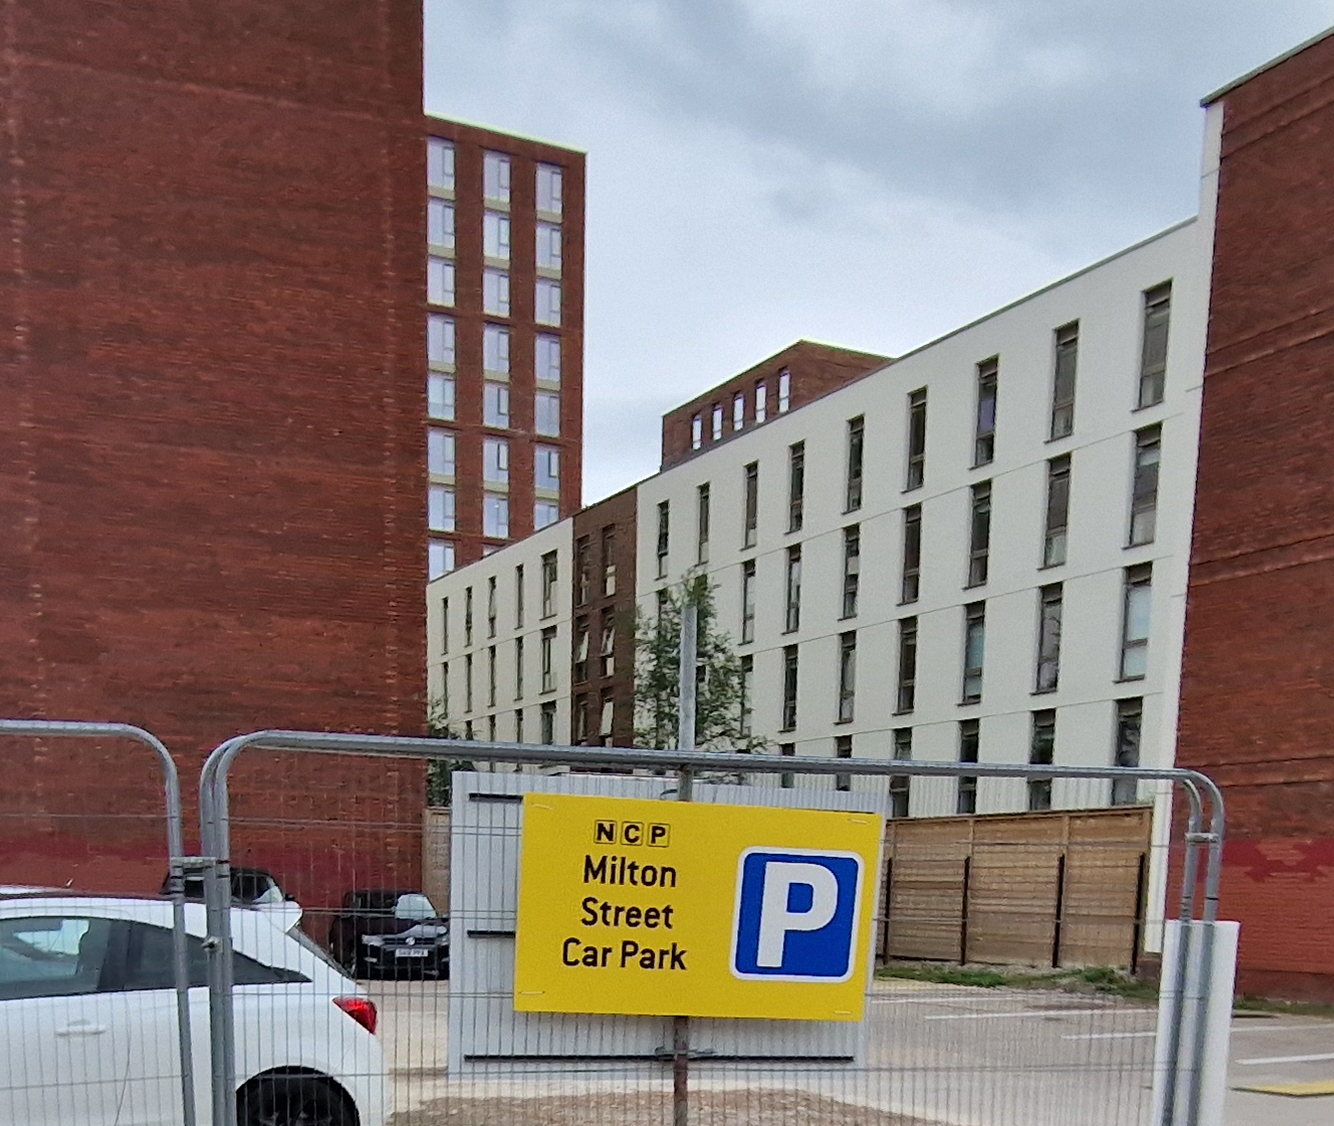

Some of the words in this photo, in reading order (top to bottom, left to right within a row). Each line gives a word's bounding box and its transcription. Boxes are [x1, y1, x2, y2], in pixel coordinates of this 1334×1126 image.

[583, 854, 677, 887] Milton
[581, 896, 674, 929] Street
[756, 861, 839, 968] P
[562, 937, 612, 967] Car
[620, 940, 687, 970] Park
